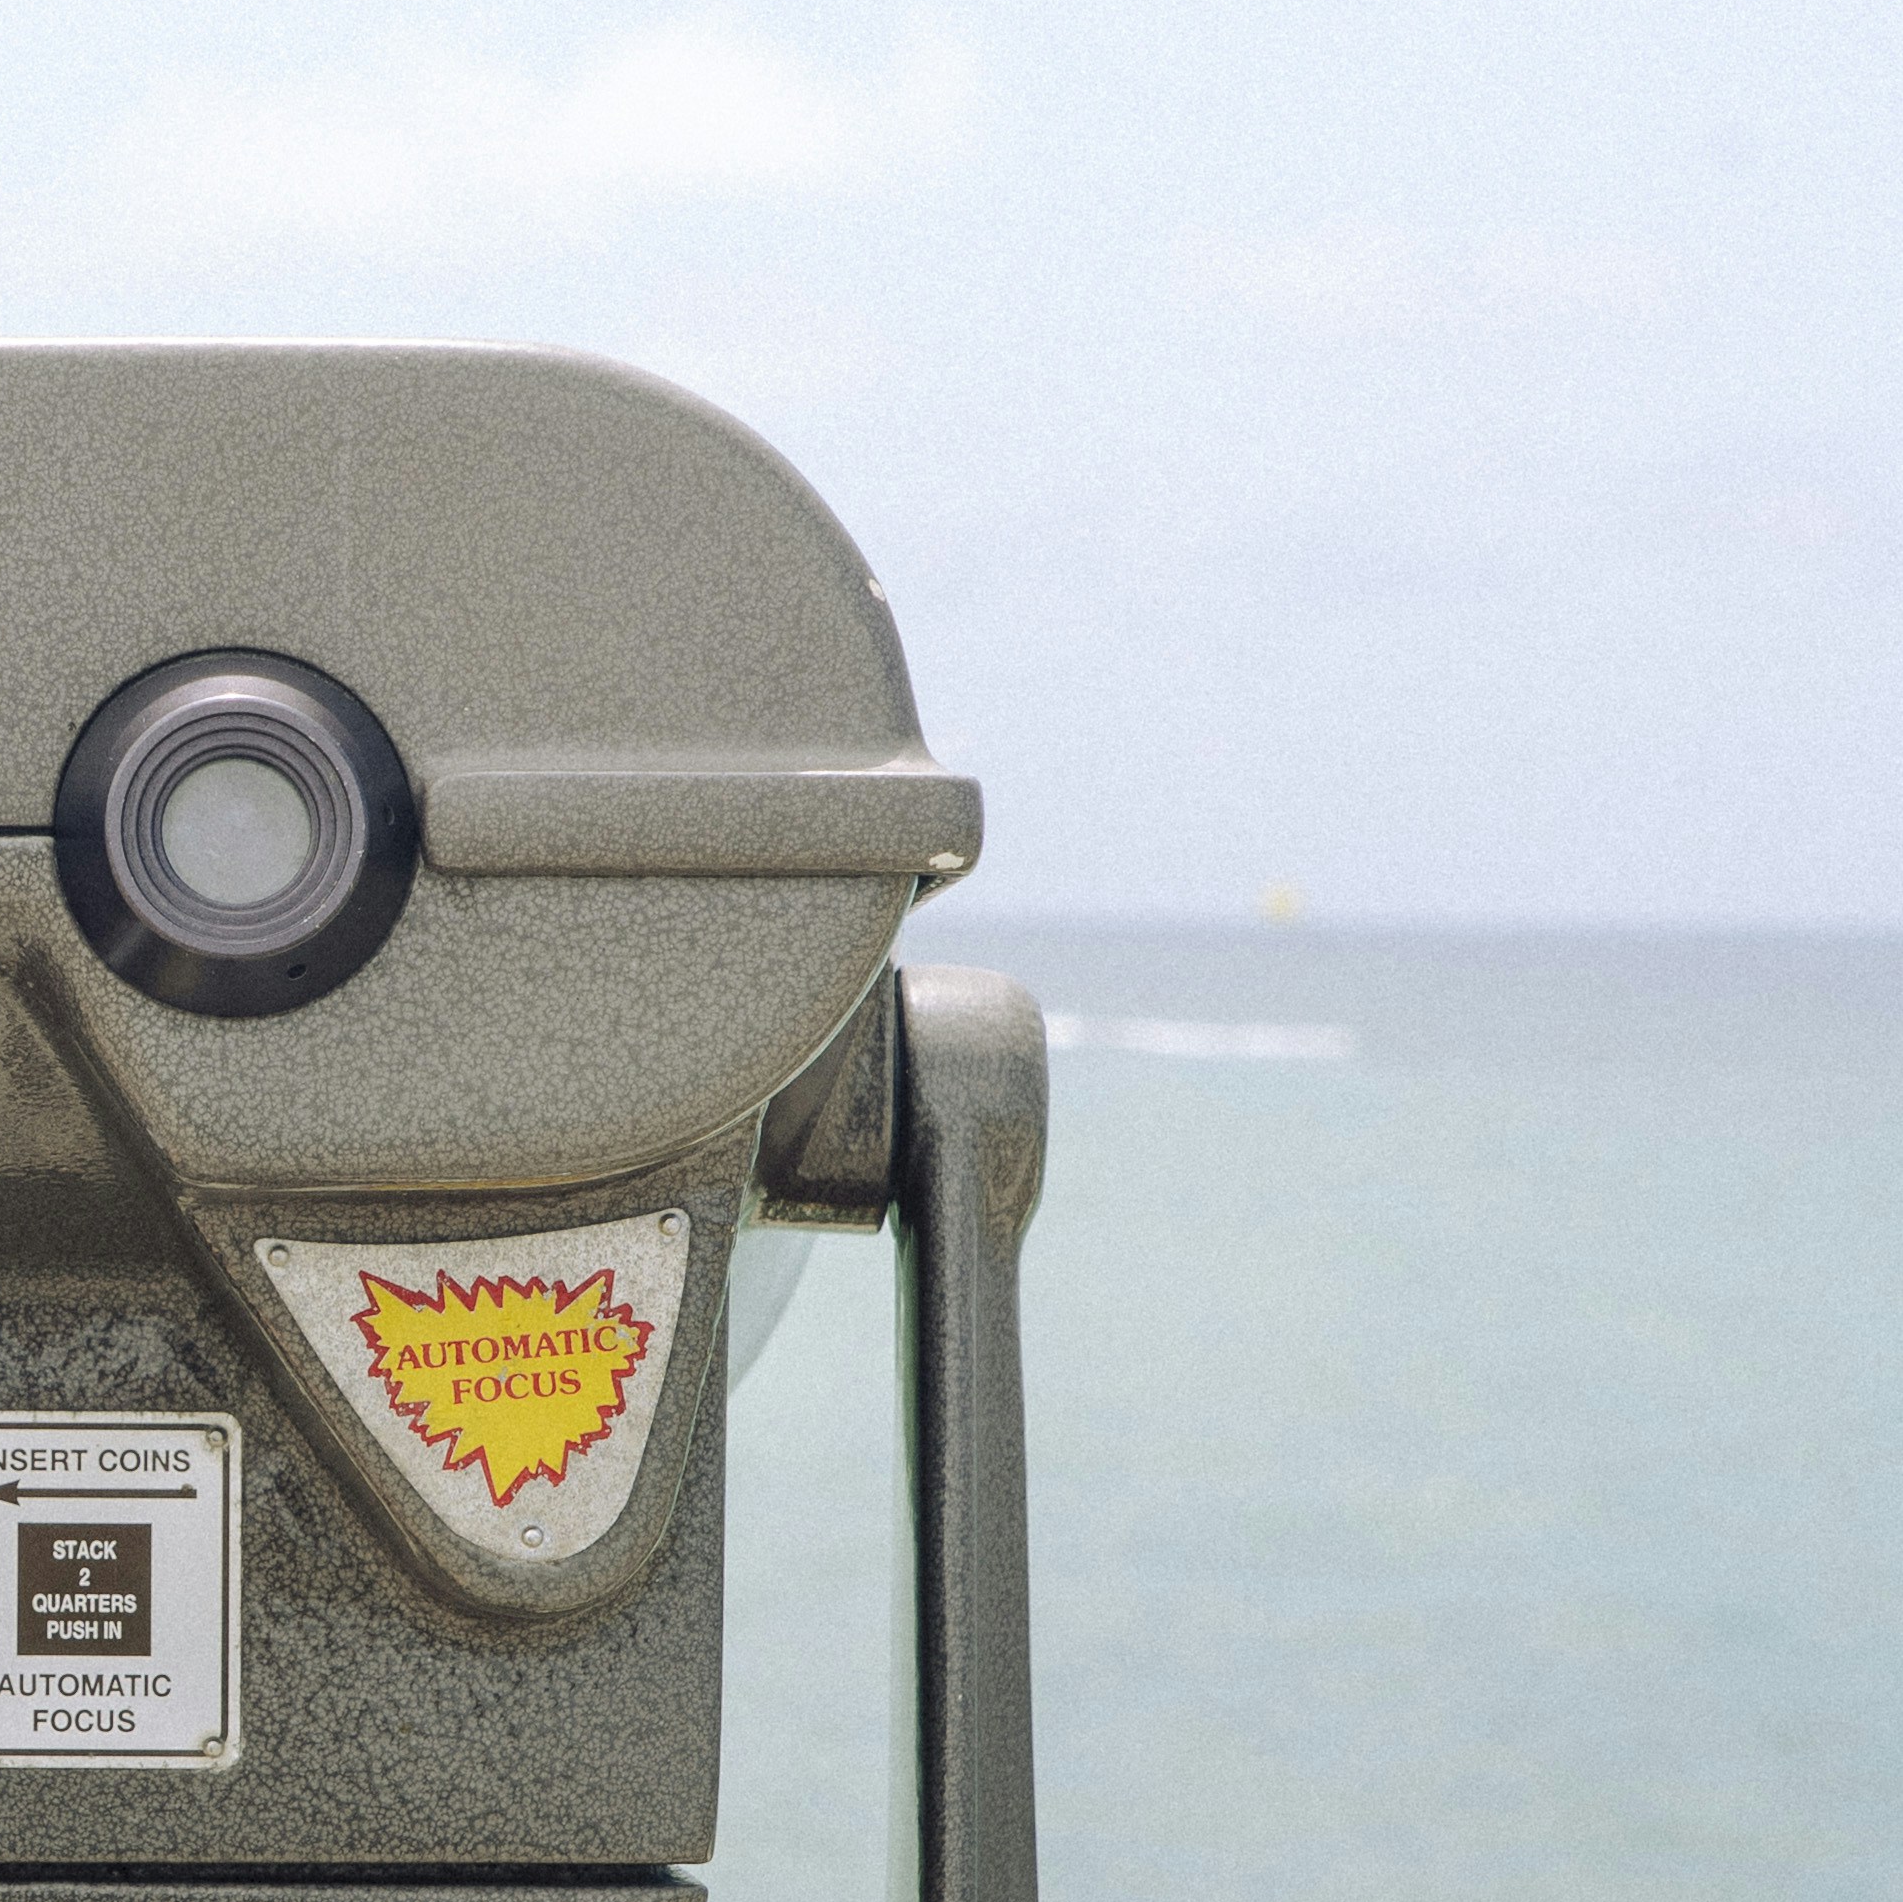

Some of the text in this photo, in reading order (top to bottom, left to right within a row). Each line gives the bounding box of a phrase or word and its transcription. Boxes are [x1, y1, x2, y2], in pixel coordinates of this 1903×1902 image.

[396, 1326, 619, 1370] AUTOMATIC
[452, 1370, 582, 1405] FOCUS
[98, 1449, 191, 1472] COINS
[52, 1540, 117, 1560] STACK
[78, 1567, 91, 1587] 2
[31, 1593, 137, 1614] QUARTERS
[46, 1620, 122, 1640] PUSH IN
[32, 1709, 135, 1733] FOCUS
